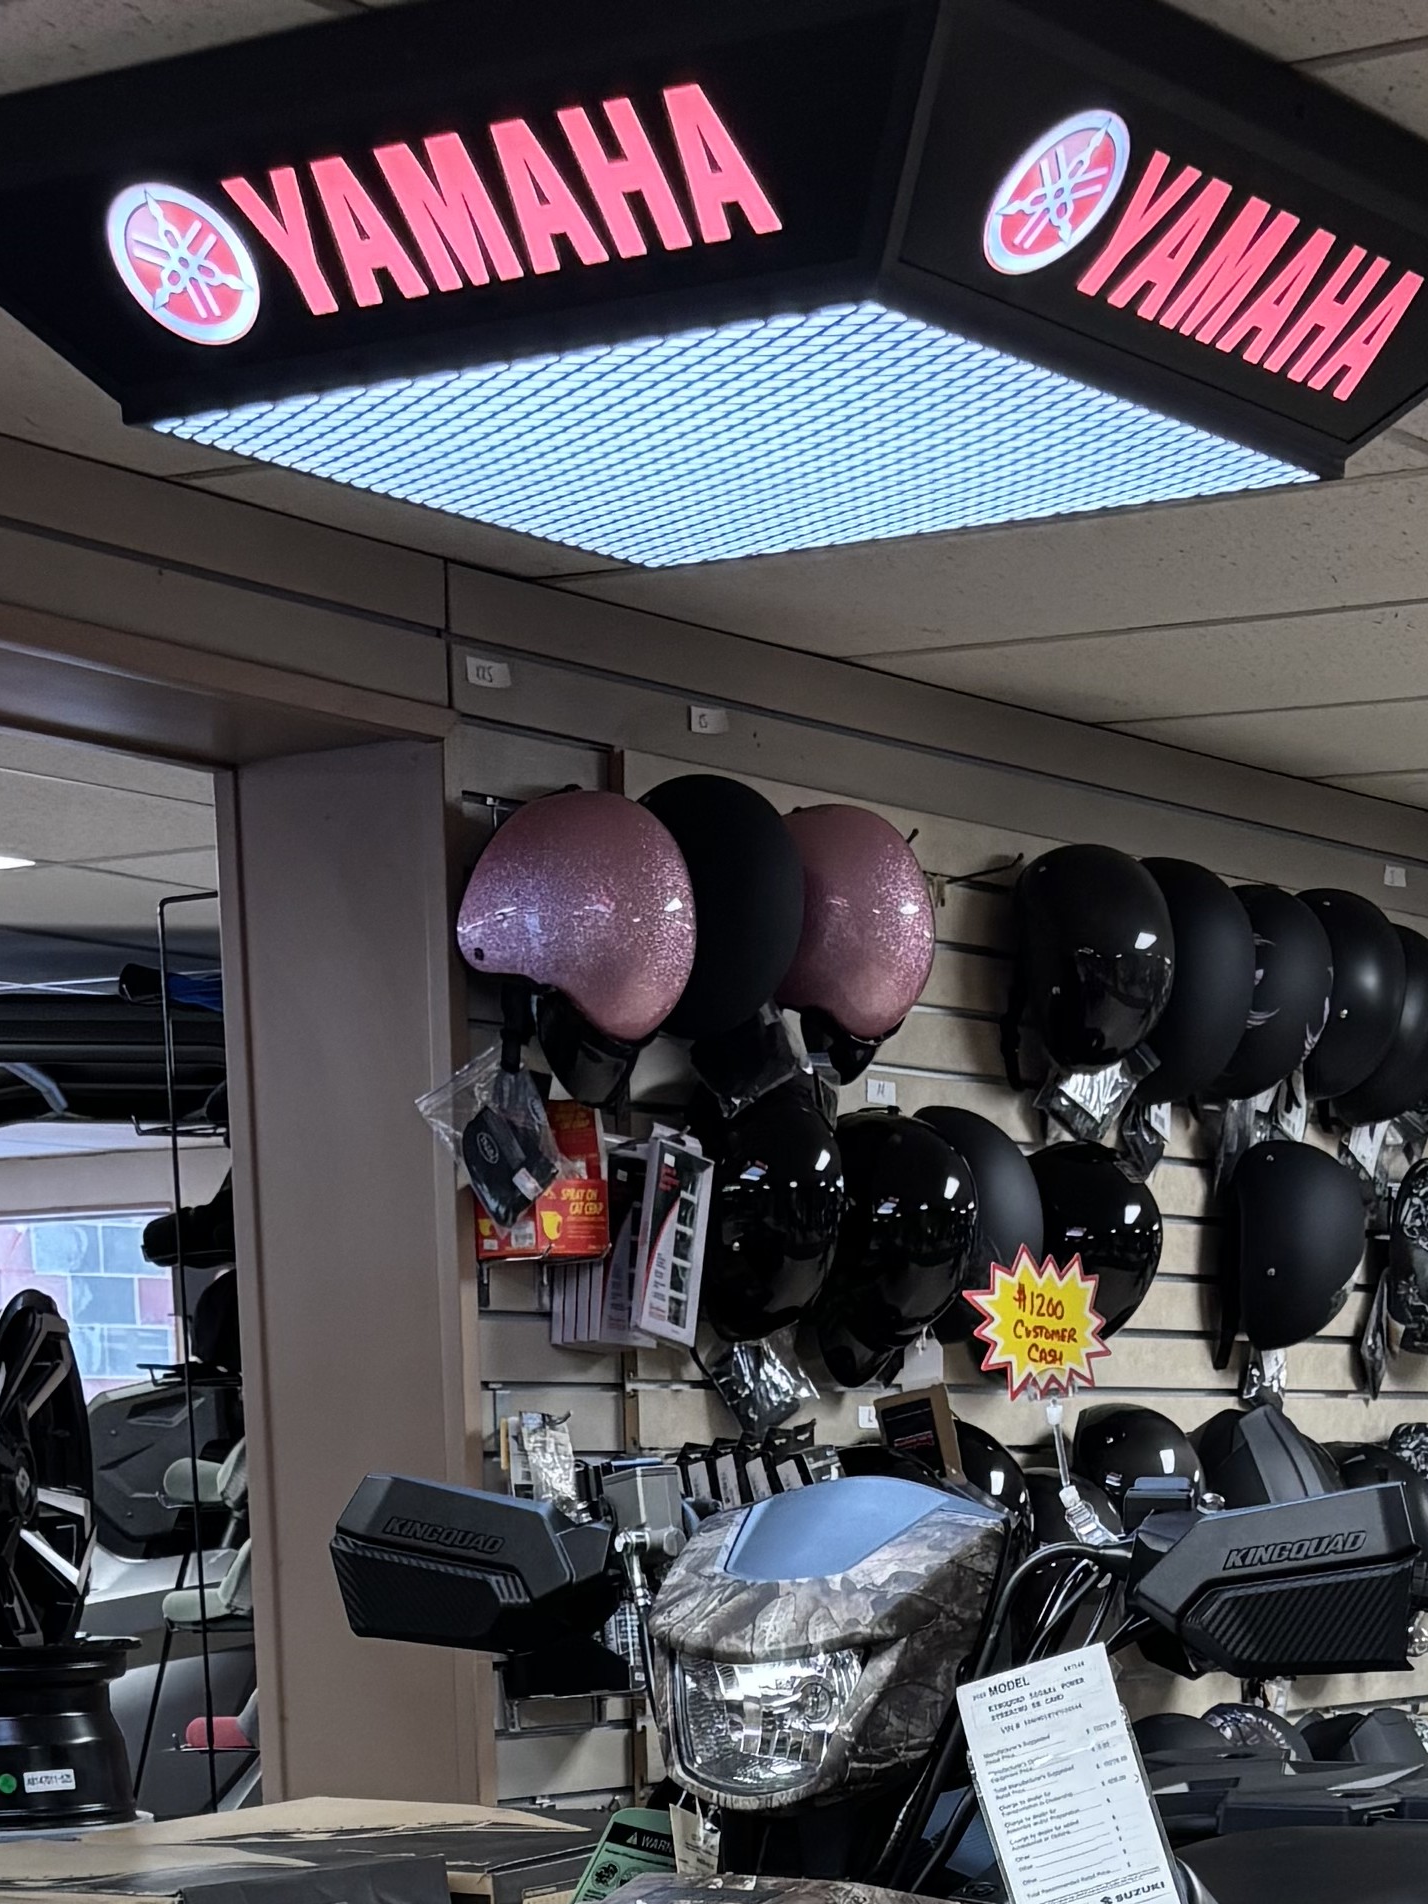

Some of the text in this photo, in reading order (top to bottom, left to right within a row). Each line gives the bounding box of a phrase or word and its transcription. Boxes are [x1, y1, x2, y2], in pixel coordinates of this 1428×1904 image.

[221, 82, 783, 316] YAMAHA
[1077, 150, 1424, 401] YAMAHA
[382, 1516, 505, 1555] KINGQUAD
[1222, 1530, 1367, 1571] KINGQUAD
[987, 1676, 1030, 1697] MODEL
[641, 1835, 673, 1854] WARN
[1116, 1881, 1165, 1903] SUZUKI
